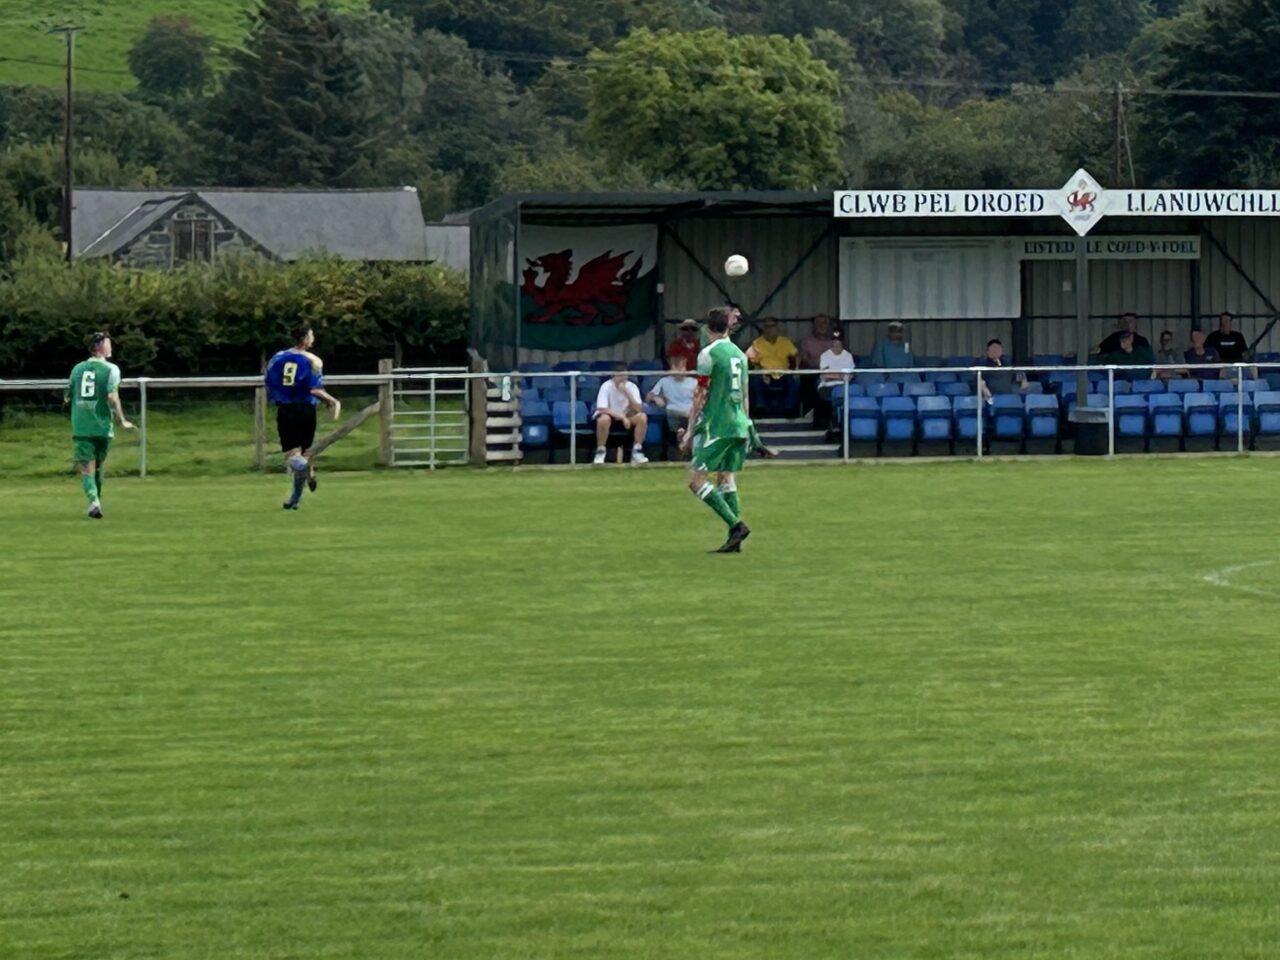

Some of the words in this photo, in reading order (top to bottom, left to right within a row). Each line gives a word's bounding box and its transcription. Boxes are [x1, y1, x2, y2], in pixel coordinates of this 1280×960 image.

[839, 193, 906, 214] CLWB
[914, 193, 956, 213] PEL
[964, 193, 1044, 213] DROED
[81, 370, 96, 397] 6
[282, 361, 298, 386] 9
